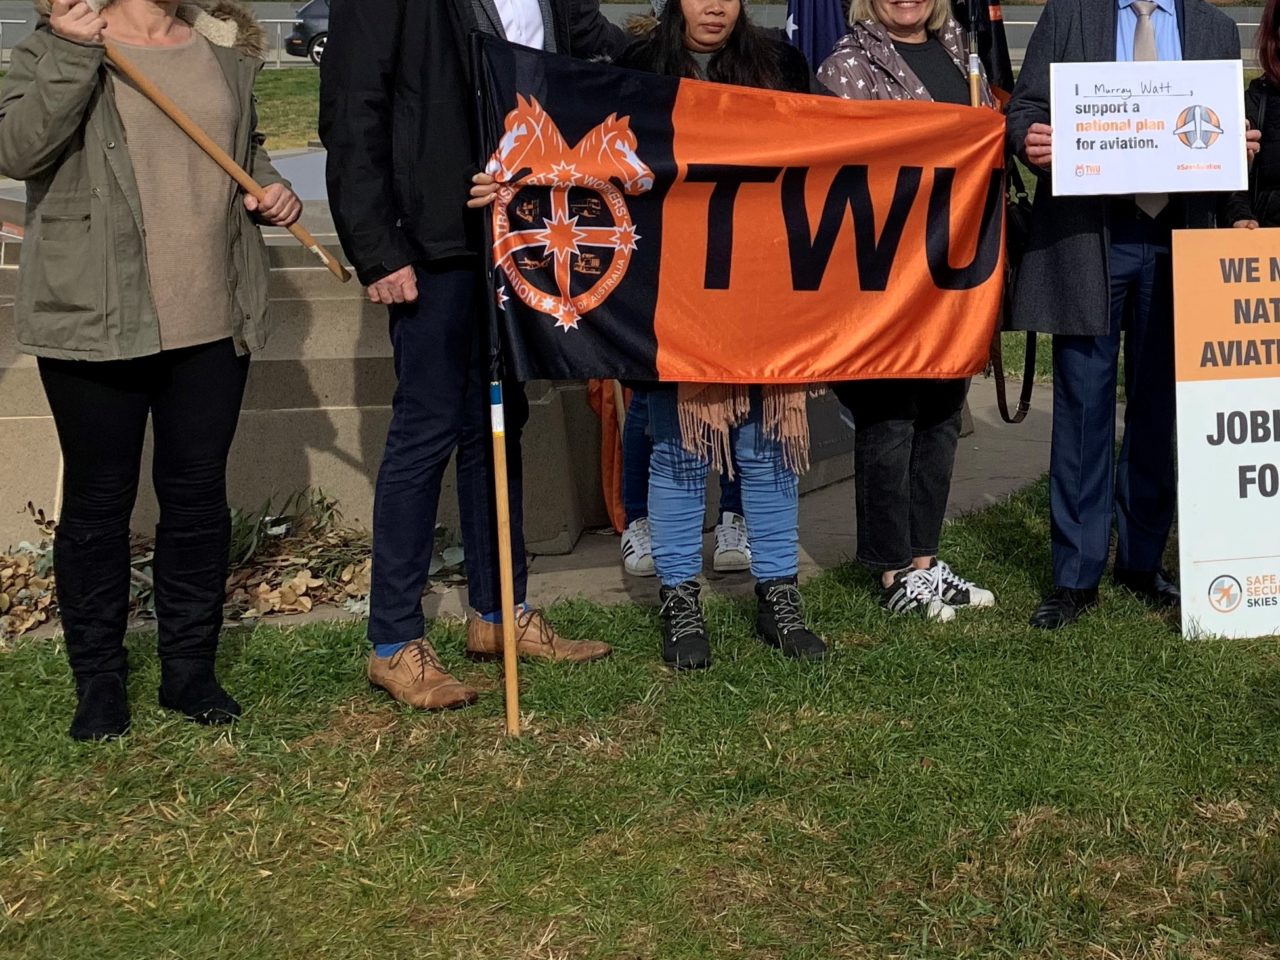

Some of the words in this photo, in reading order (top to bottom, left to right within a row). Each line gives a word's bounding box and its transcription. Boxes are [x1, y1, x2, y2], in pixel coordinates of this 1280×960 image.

[1075, 83, 1079, 97] I
[1094, 83, 1133, 101] Murray
[1140, 81, 1172, 95] Watt
[1075, 101, 1129, 117] support
[1132, 103, 1140, 113] a
[1075, 119, 1131, 133] national
[1135, 119, 1165, 134] plan
[1075, 137, 1096, 151] for
[1099, 136, 1159, 151] aviation.
[683, 163, 1002, 292] TWU
[1219, 257, 1261, 284] WE
[504, 260, 539, 306] UNION
[577, 299, 588, 309] OF
[591, 259, 625, 305] AUSTRALIA
[1246, 574, 1277, 586] SAFE
[1246, 596, 1278, 608] SKIES
